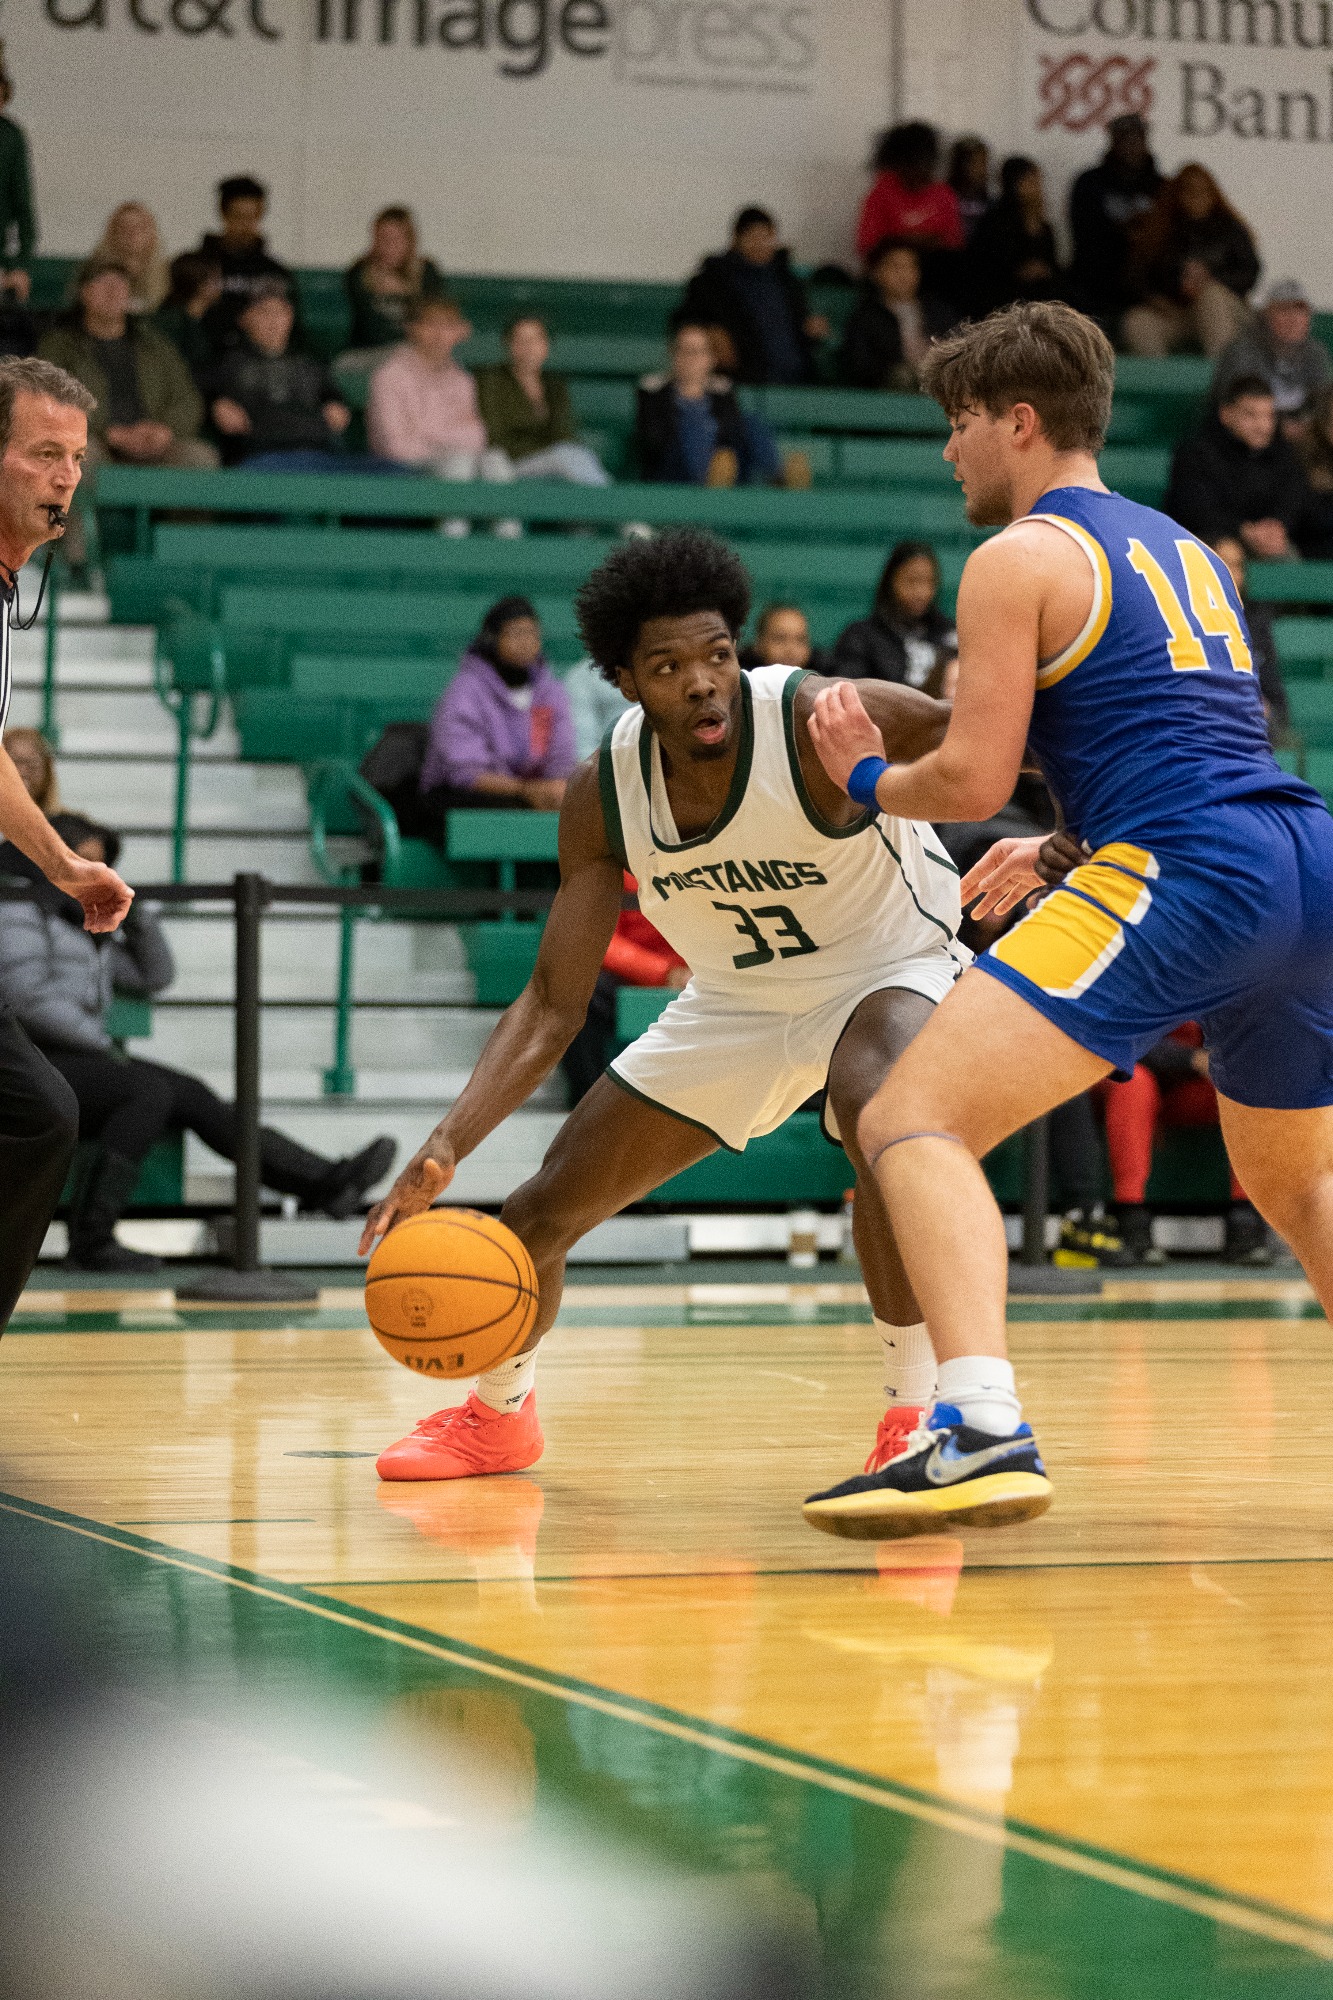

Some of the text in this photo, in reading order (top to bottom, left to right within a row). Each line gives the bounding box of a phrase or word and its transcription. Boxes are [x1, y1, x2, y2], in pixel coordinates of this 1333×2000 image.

[1180, 61, 1333, 142] Ban
[1126, 538, 1253, 675] 14
[711, 901, 820, 969] 33
